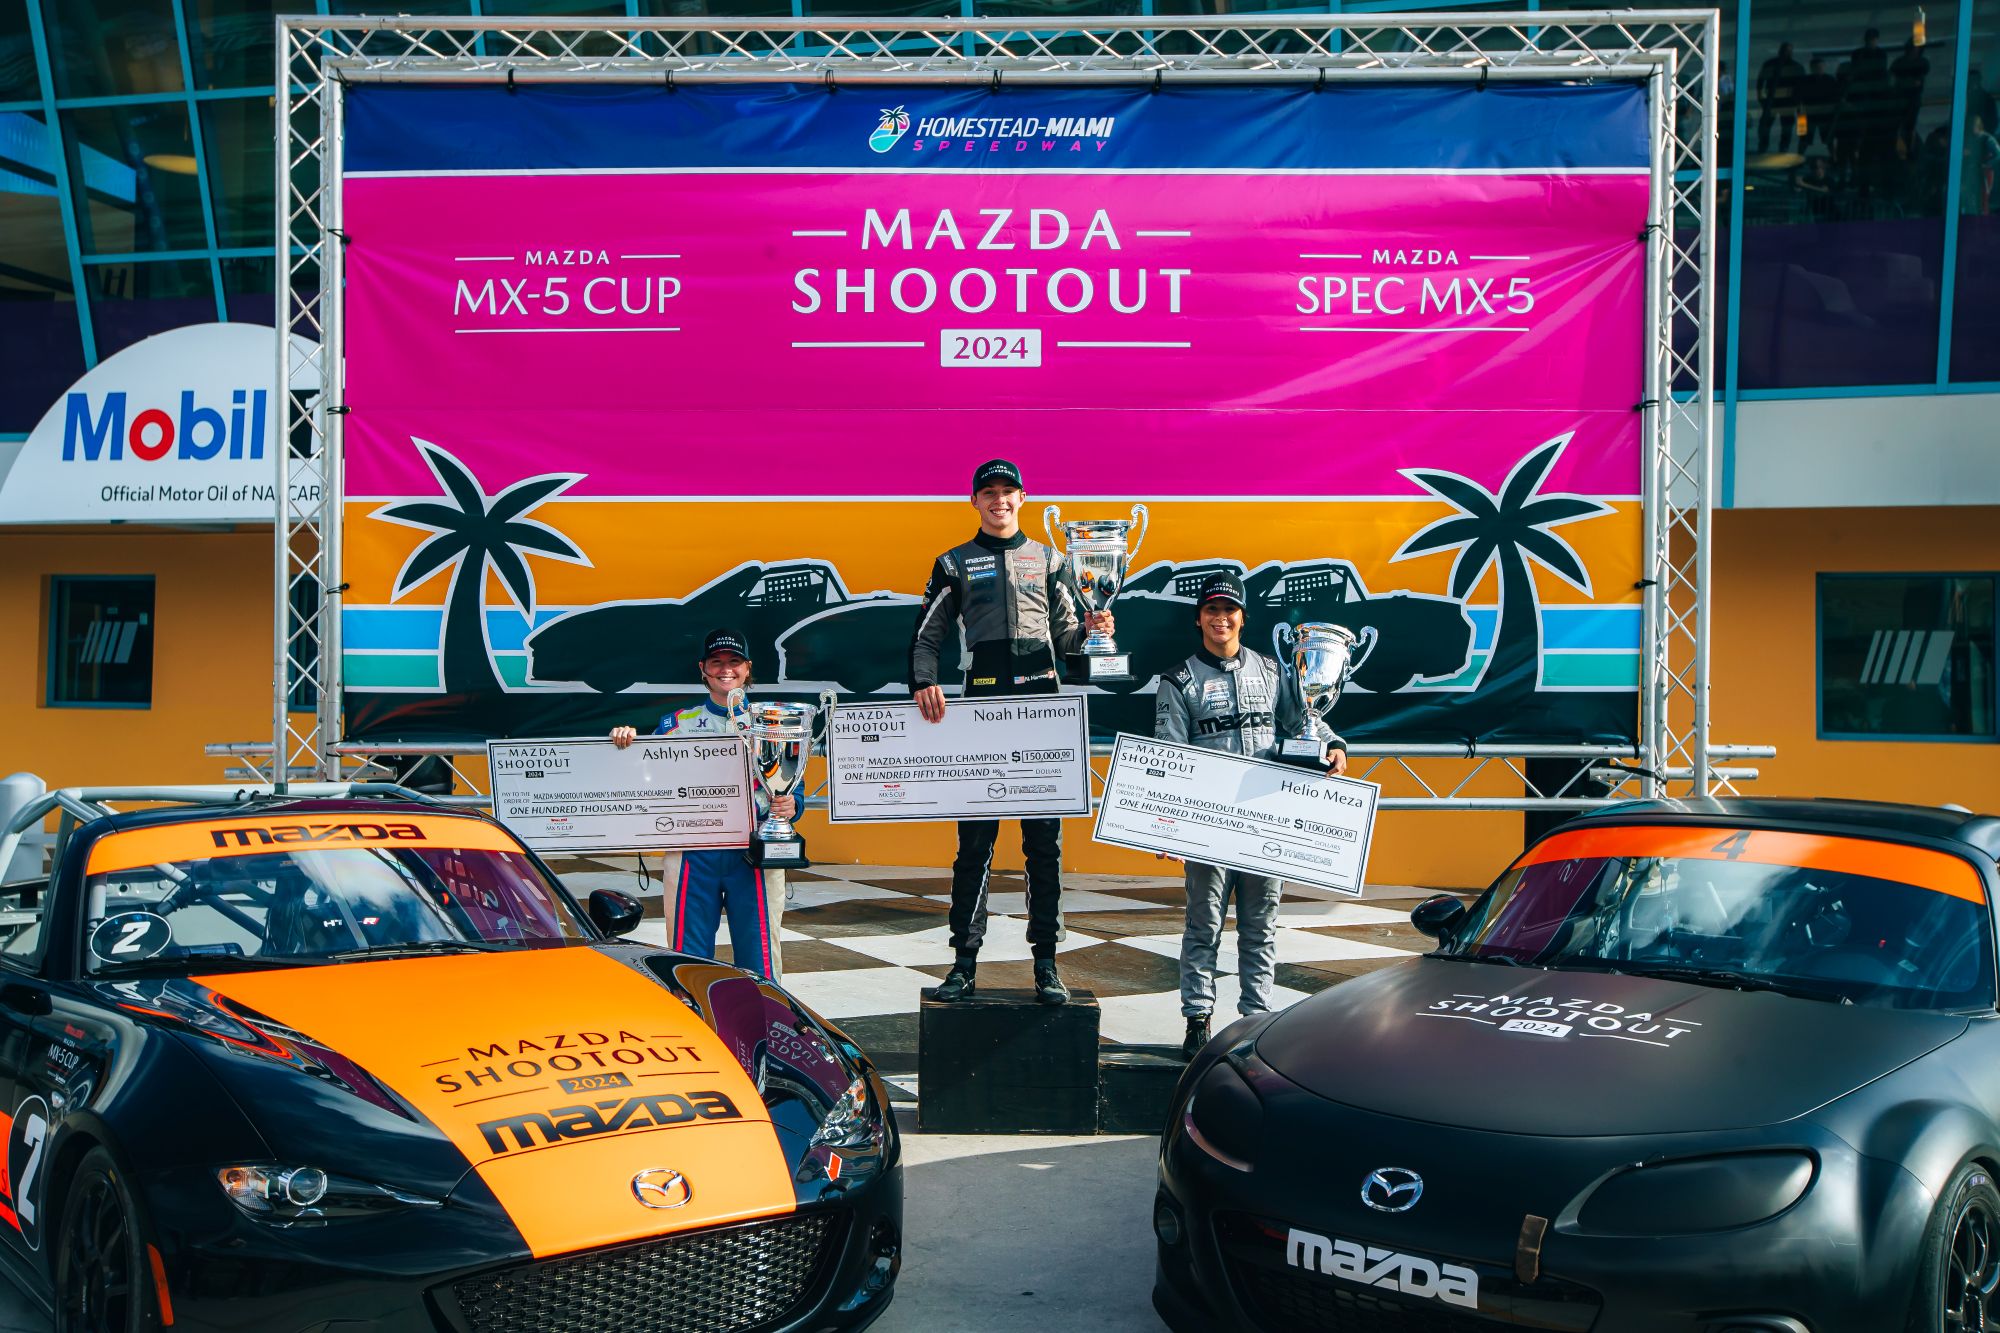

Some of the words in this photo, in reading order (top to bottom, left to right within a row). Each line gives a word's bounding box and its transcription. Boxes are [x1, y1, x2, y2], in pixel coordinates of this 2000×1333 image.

[916, 117, 1115, 138] HOMESTEAD-MIAMI
[913, 140, 1108, 152] SPEEDWAY
[861, 208, 1122, 251] MAZDA
[525, 250, 610, 266] MAZDA
[1372, 249, 1459, 265] MAZDA
[454, 277, 570, 316] MX-5
[583, 277, 682, 315] CUP
[791, 267, 1191, 314] SHOOTOUT
[1296, 276, 1406, 315] SPEC
[1420, 277, 1535, 315] MX-5
[952, 336, 1029, 360] 2024
[62, 389, 267, 462] Mobil
[101, 486, 154, 501] Official
[159, 486, 204, 501] Motor
[207, 485, 228, 500] Oil
[232, 484, 248, 500] of
[252, 485, 321, 500] NACAR
[846, 710, 893, 721] MAZDA
[974, 709, 1012, 722] Noah
[1017, 706, 1076, 720] Harmon
[1198, 711, 1273, 735] mazda
[835, 721, 906, 733] SHOOTOUT
[508, 747, 557, 758] MAZDA
[642, 746, 689, 763] Ashlyn
[693, 743, 738, 760] Speed
[868, 758, 902, 766] MAZDA
[904, 755, 954, 765] SHOOTOUT
[955, 753, 1007, 763] CHAMPION
[1011, 750, 1021, 763] $
[1120, 752, 1196, 774] SHOOTOUT
[1136, 744, 1184, 761] MAZDA
[497, 758, 570, 770] SHOOTOUT
[844, 772, 863, 781] ONE
[865, 770, 911, 780] HUNDRED
[913, 769, 935, 778] FIFTY
[938, 768, 990, 778] THOUSAND
[554, 791, 583, 800] SHOOTOUT
[584, 790, 610, 799] WOMEN'S
[610, 789, 637, 798] INITIATIVE
[637, 789, 673, 797] SCHOLARSHIP
[678, 787, 687, 798] $
[1281, 780, 1319, 798] Helio
[1323, 789, 1363, 808] Meza
[510, 807, 529, 815] ONE
[532, 805, 578, 815] HUNDRED
[580, 803, 632, 813] THOUSAND
[1119, 798, 1139, 809] ONE
[1141, 802, 1189, 818] HUNDRED
[1191, 811, 1245, 829] THOUSAND
[1147, 790, 1182, 804] MAZDA
[1184, 797, 1234, 814] SHOOTOUT
[1236, 808, 1291, 825] RUNNER-UP
[1293, 818, 1304, 830] $
[210, 823, 428, 849] mazda
[1711, 829, 1752, 860] 4
[111, 921, 151, 954] 2
[1489, 994, 1652, 1022] MAZDA
[1429, 1000, 1692, 1039] SHOOTOUT
[1509, 1020, 1561, 1034] 2024
[467, 1031, 645, 1061] MAZDA
[435, 1046, 702, 1093] SHOOTOUT
[568, 1075, 622, 1092] 2024
[476, 1090, 744, 1155] mazda
[18, 1113, 47, 1226] 2
[1286, 1227, 1479, 1310] mazda
